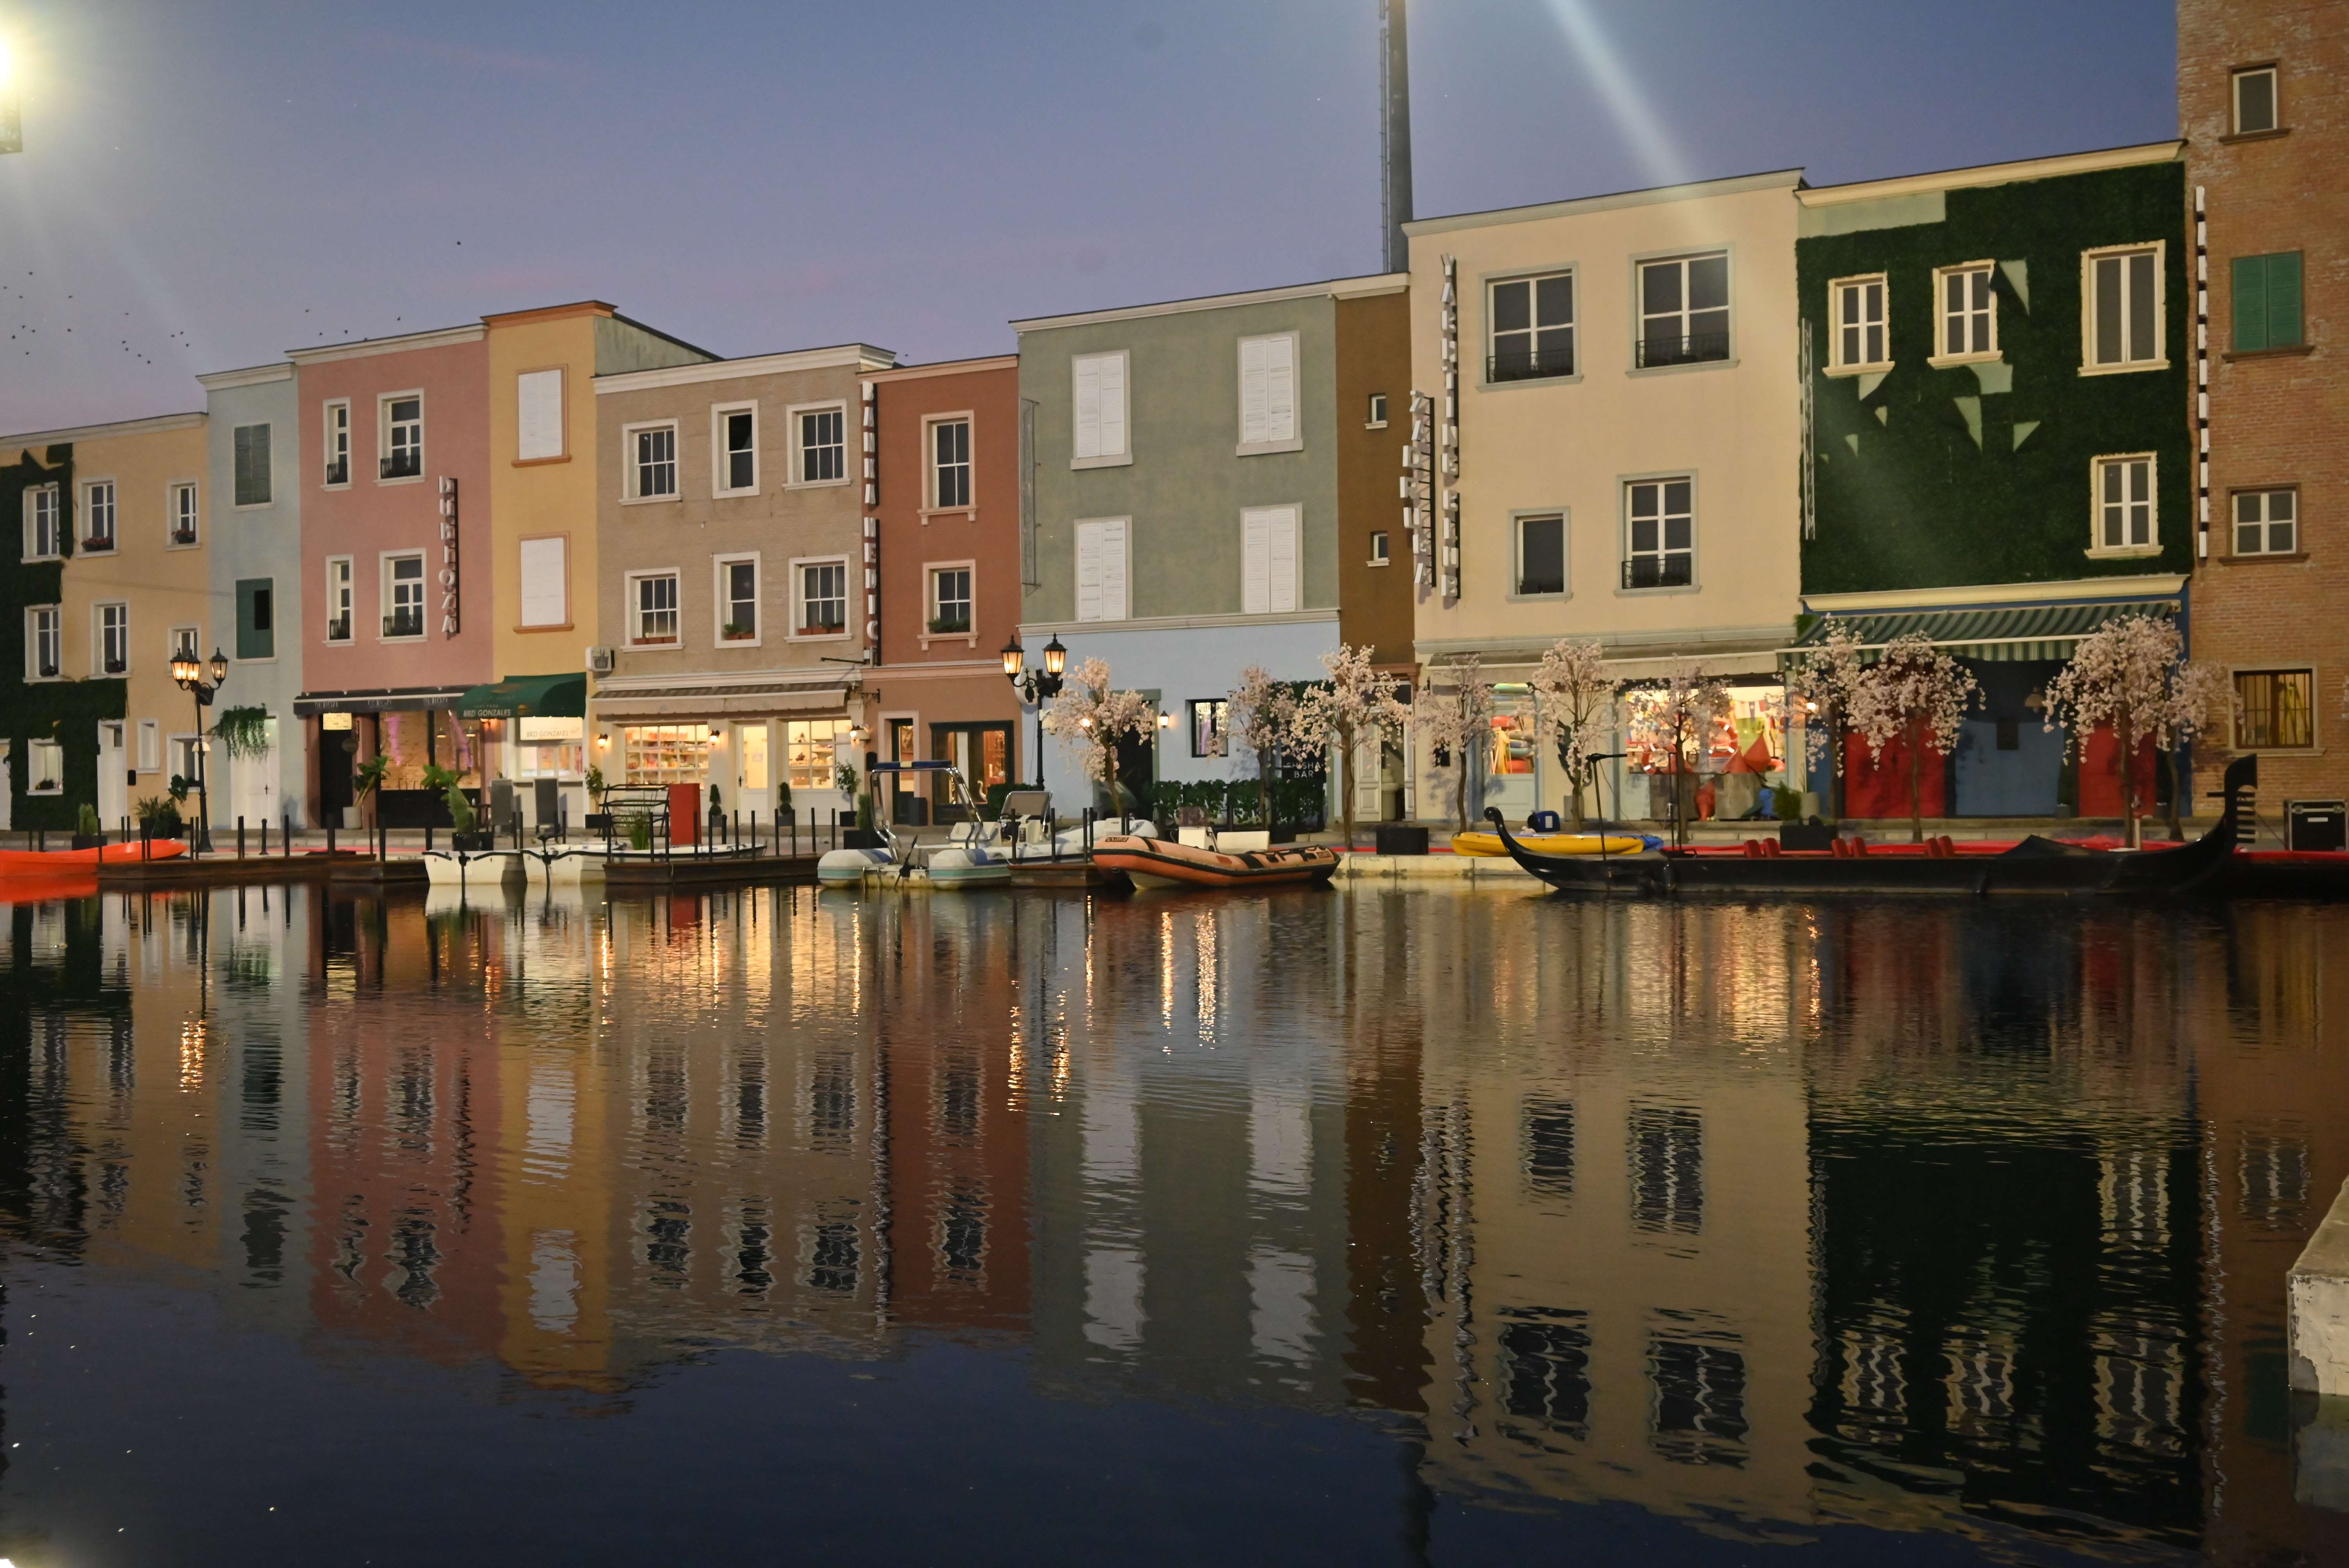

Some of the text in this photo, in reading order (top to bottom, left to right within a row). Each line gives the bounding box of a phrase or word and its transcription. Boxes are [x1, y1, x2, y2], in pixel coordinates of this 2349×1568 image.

[1399, 390, 1431, 585] ZADRUGA
[1441, 490, 1459, 597] CLUB
[438, 475, 456, 633] DUBIOZA
[478, 709, 511, 717] GONZALES
